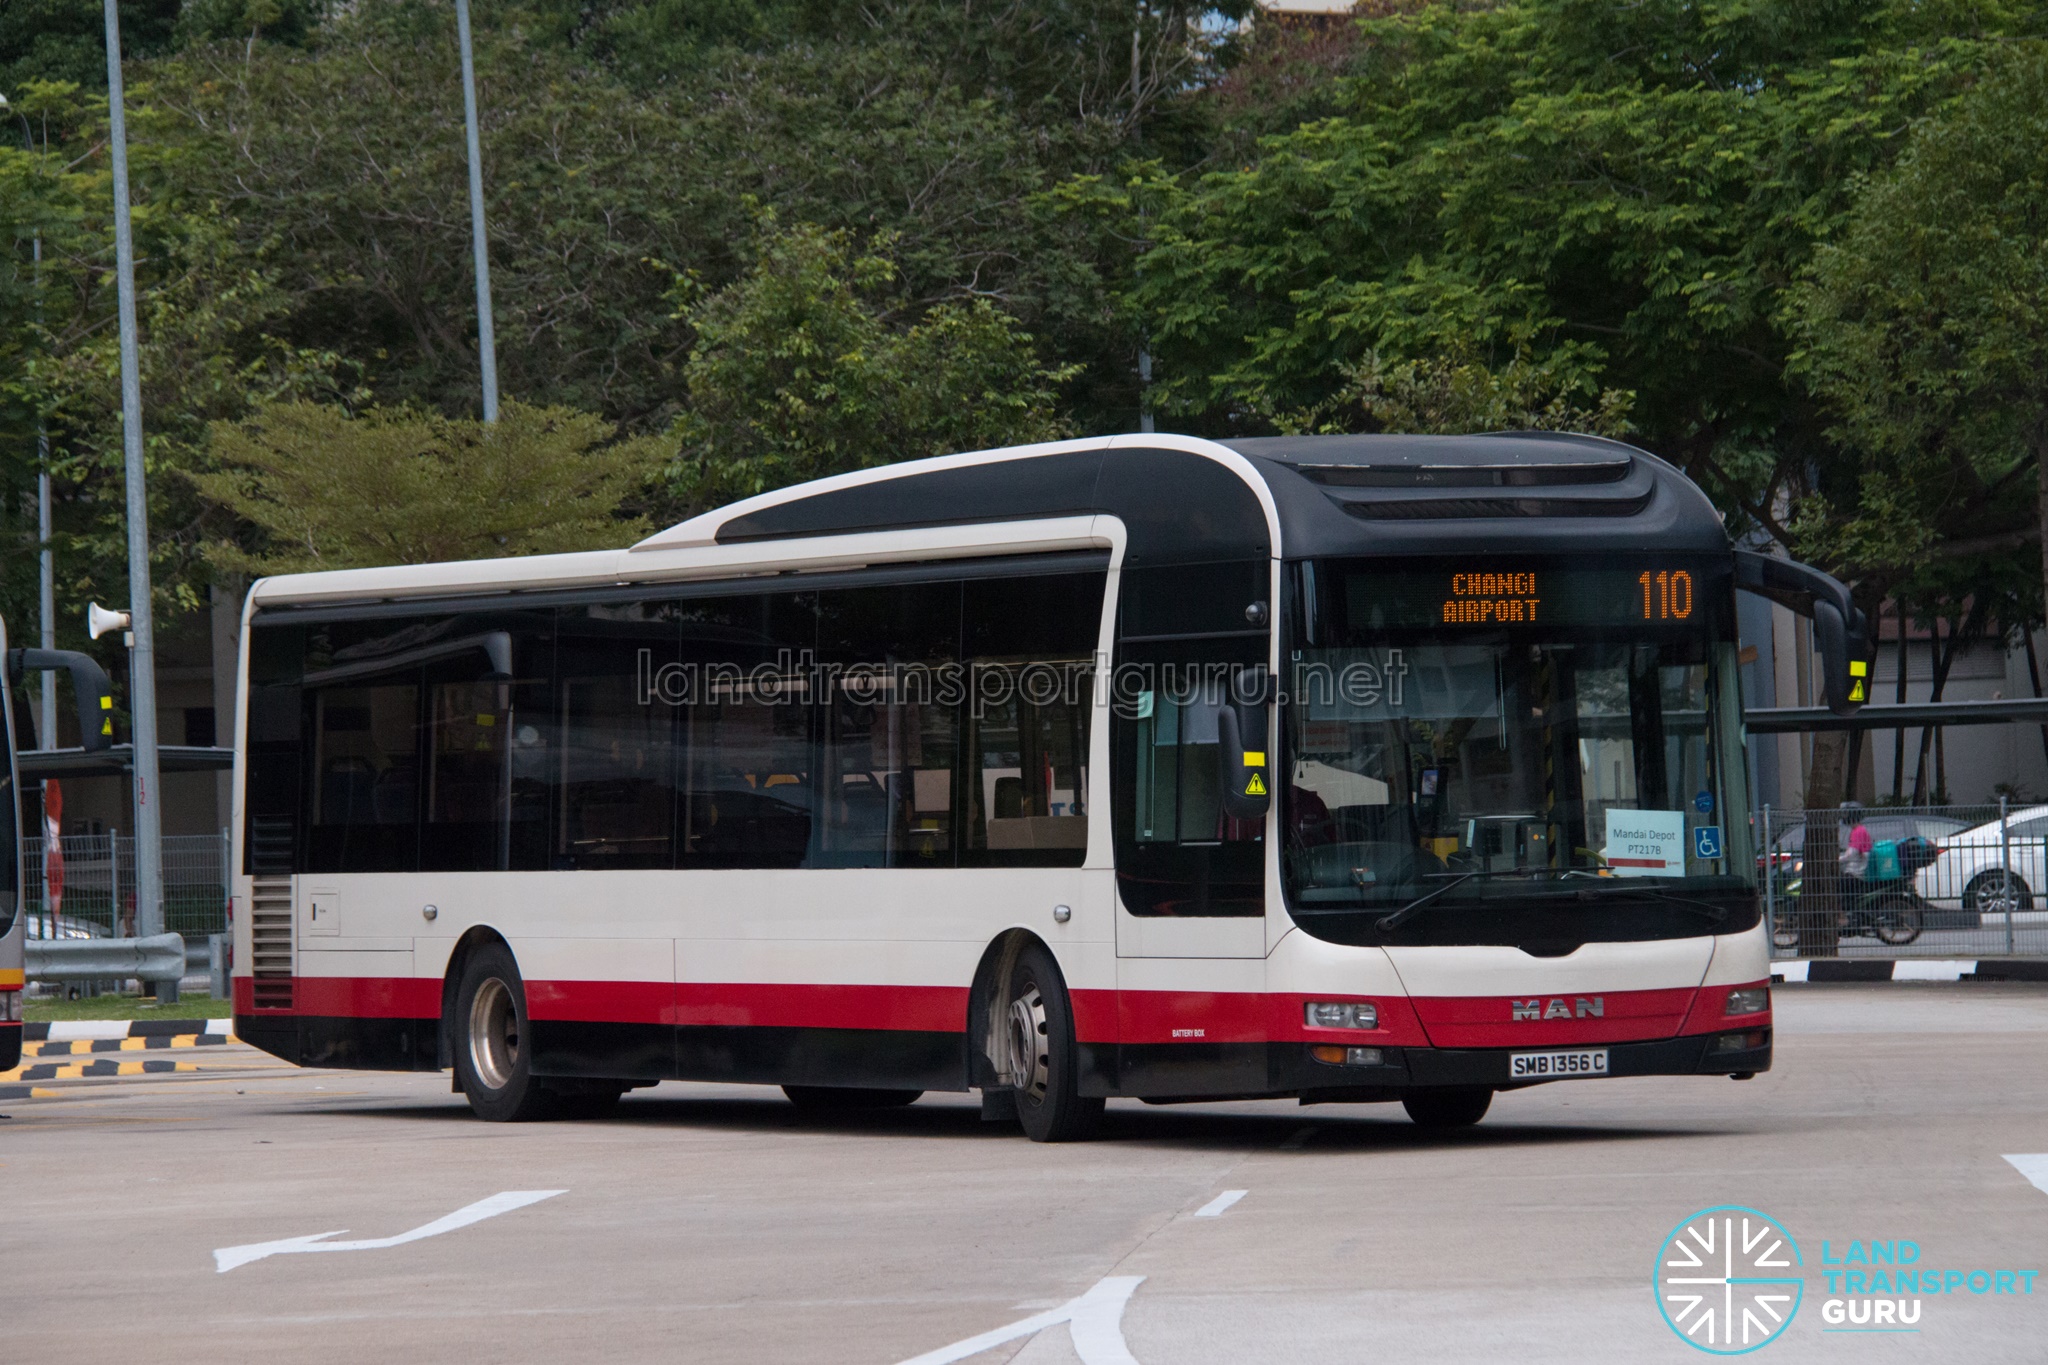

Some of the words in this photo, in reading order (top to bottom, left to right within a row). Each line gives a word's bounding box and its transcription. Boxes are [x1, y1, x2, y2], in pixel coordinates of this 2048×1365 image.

[1452, 573, 1535, 595] CHANGI
[1638, 570, 1692, 619] 110
[1443, 599, 1541, 622] AIRPORT
[1613, 829, 1647, 839] Mandai
[1649, 830, 1676, 841] Depot
[1627, 844, 1662, 855] PT217B
[1512, 997, 1604, 1021] MAN
[1172, 1029, 1194, 1037] BATTERY
[1194, 1029, 1205, 1037] BOX
